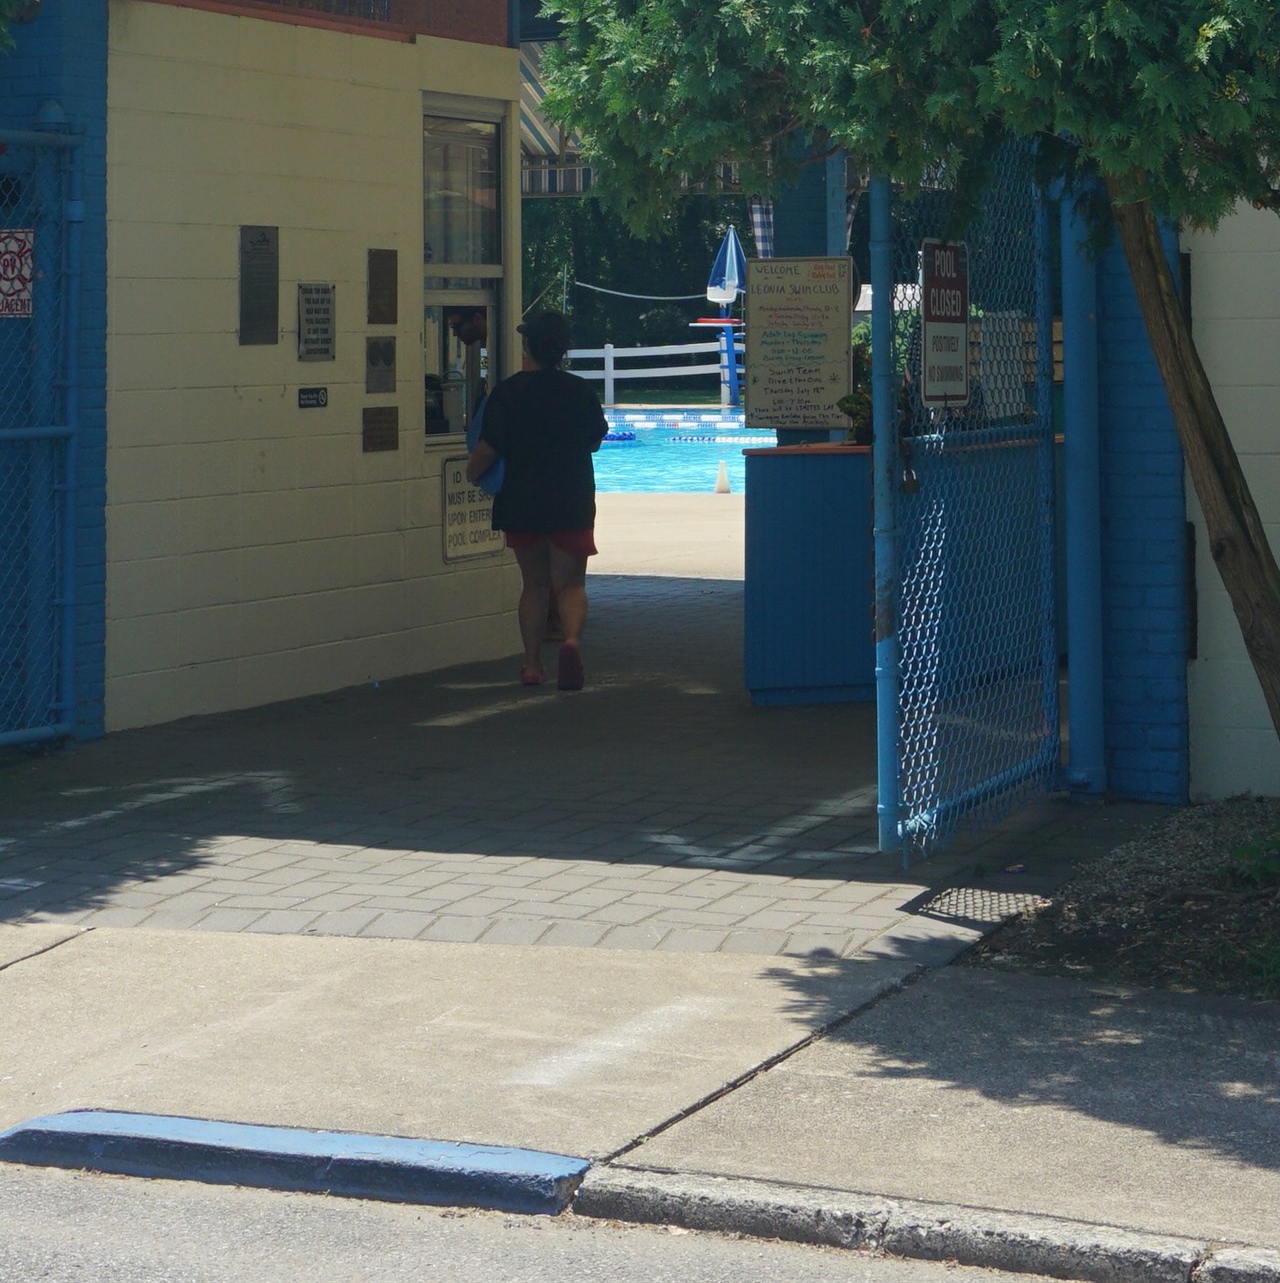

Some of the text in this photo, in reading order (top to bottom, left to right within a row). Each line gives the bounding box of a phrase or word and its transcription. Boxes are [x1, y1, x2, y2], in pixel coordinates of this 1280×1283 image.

[755, 265, 800, 276] WELCOME
[934, 250, 956, 278] POOL
[751, 284, 786, 294] LEONIA
[930, 288, 962, 317] CLOSED
[932, 336, 960, 352] POSITIVELY
[453, 471, 462, 484] ID
[448, 491, 465, 505] MUST
[468, 490, 476, 503] BE
[448, 509, 491, 526] UPON ENTER
[448, 532, 466, 548] POOL
